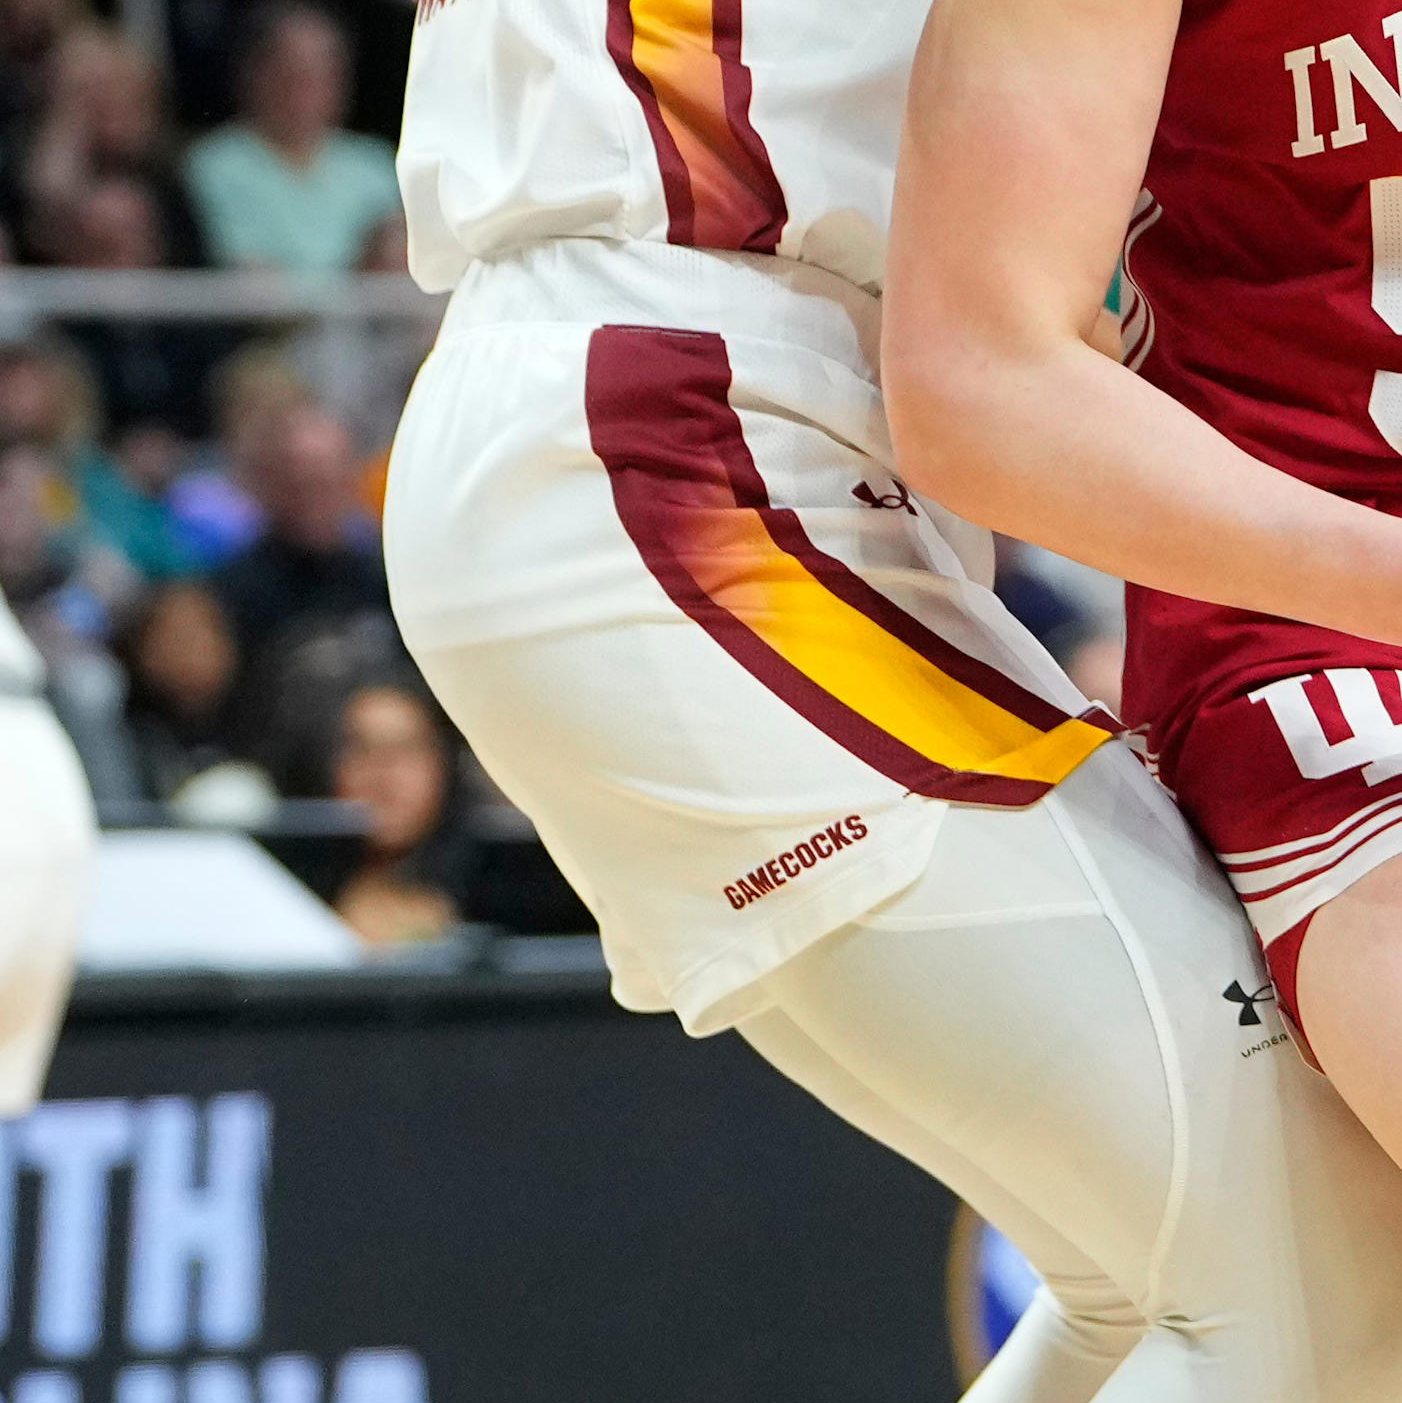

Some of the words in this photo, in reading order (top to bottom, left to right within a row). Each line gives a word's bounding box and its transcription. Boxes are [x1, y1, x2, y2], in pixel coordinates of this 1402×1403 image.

[723, 814, 868, 910] GAMECOCKS
[1241, 1033, 1288, 1058] UNDER
[0, 1092, 273, 1359] TH
